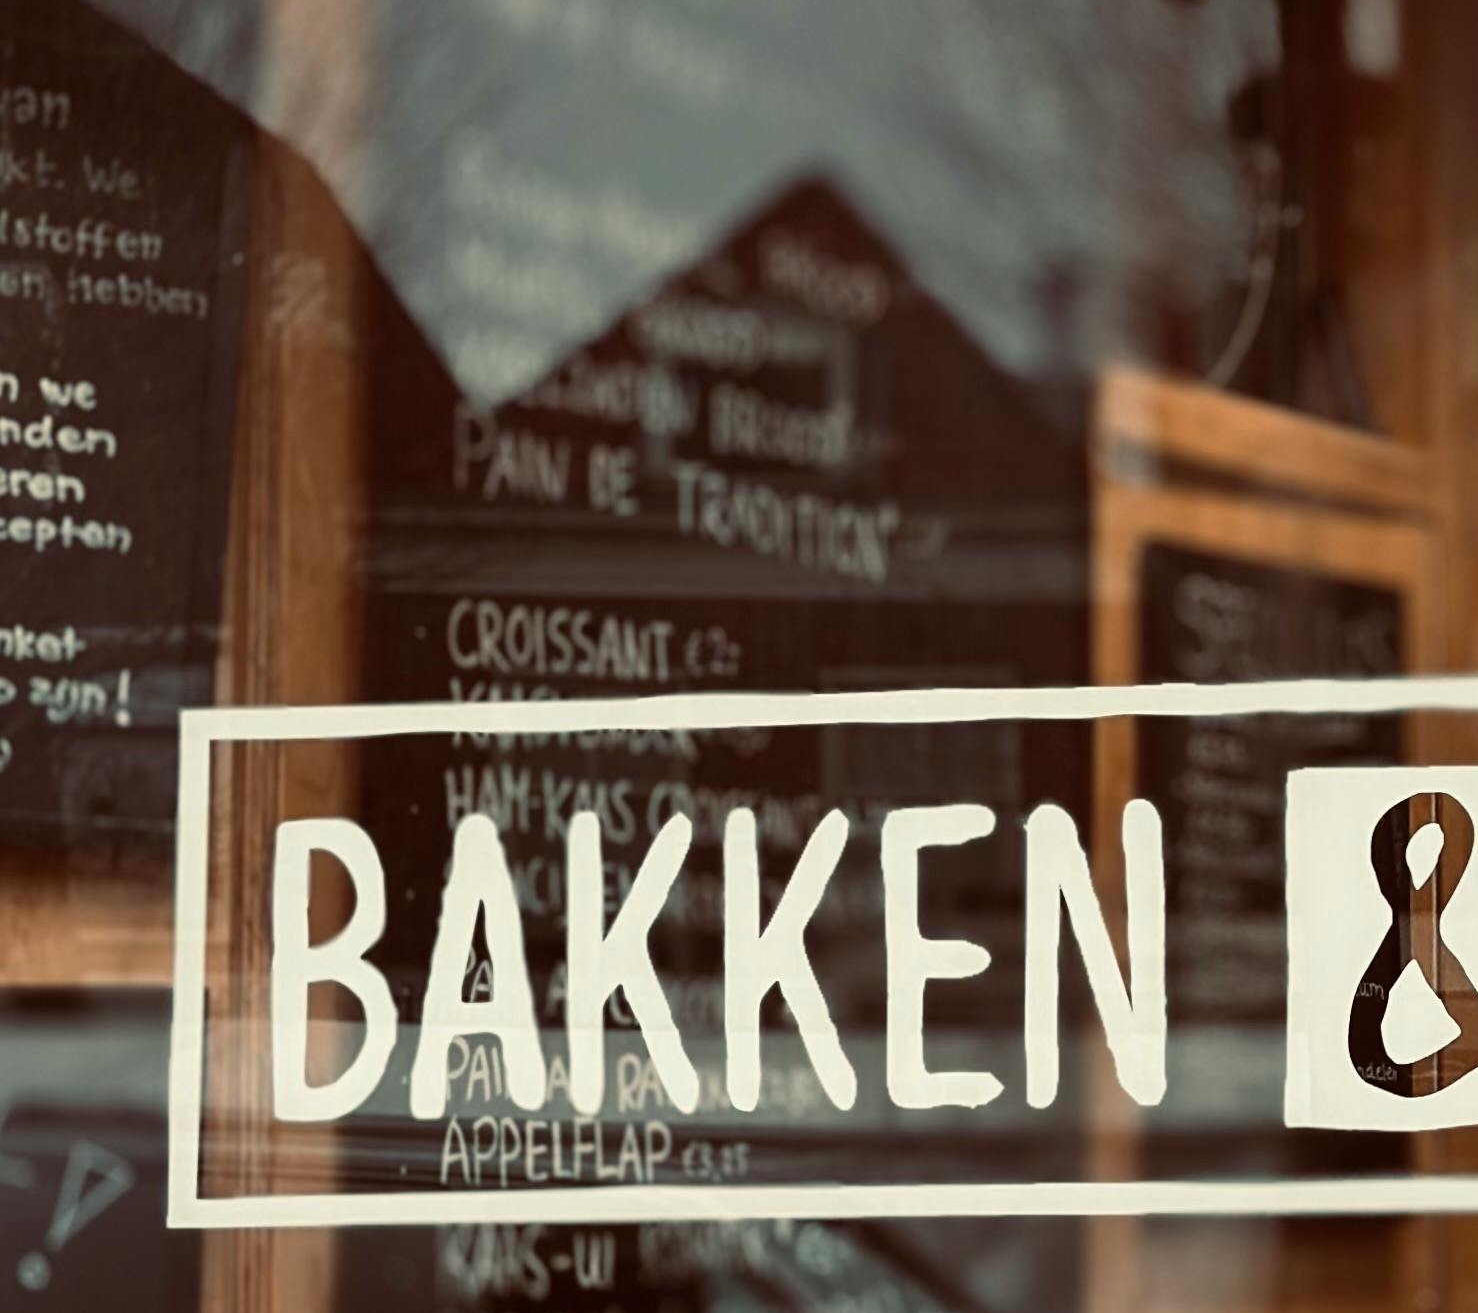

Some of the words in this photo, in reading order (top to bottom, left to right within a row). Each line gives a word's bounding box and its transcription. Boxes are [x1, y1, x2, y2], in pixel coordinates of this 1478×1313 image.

[447, 598, 675, 683] CROISSANT
[271, 799, 1168, 1123] BAKKEN
[440, 1115, 672, 1186] APPELFLAP
